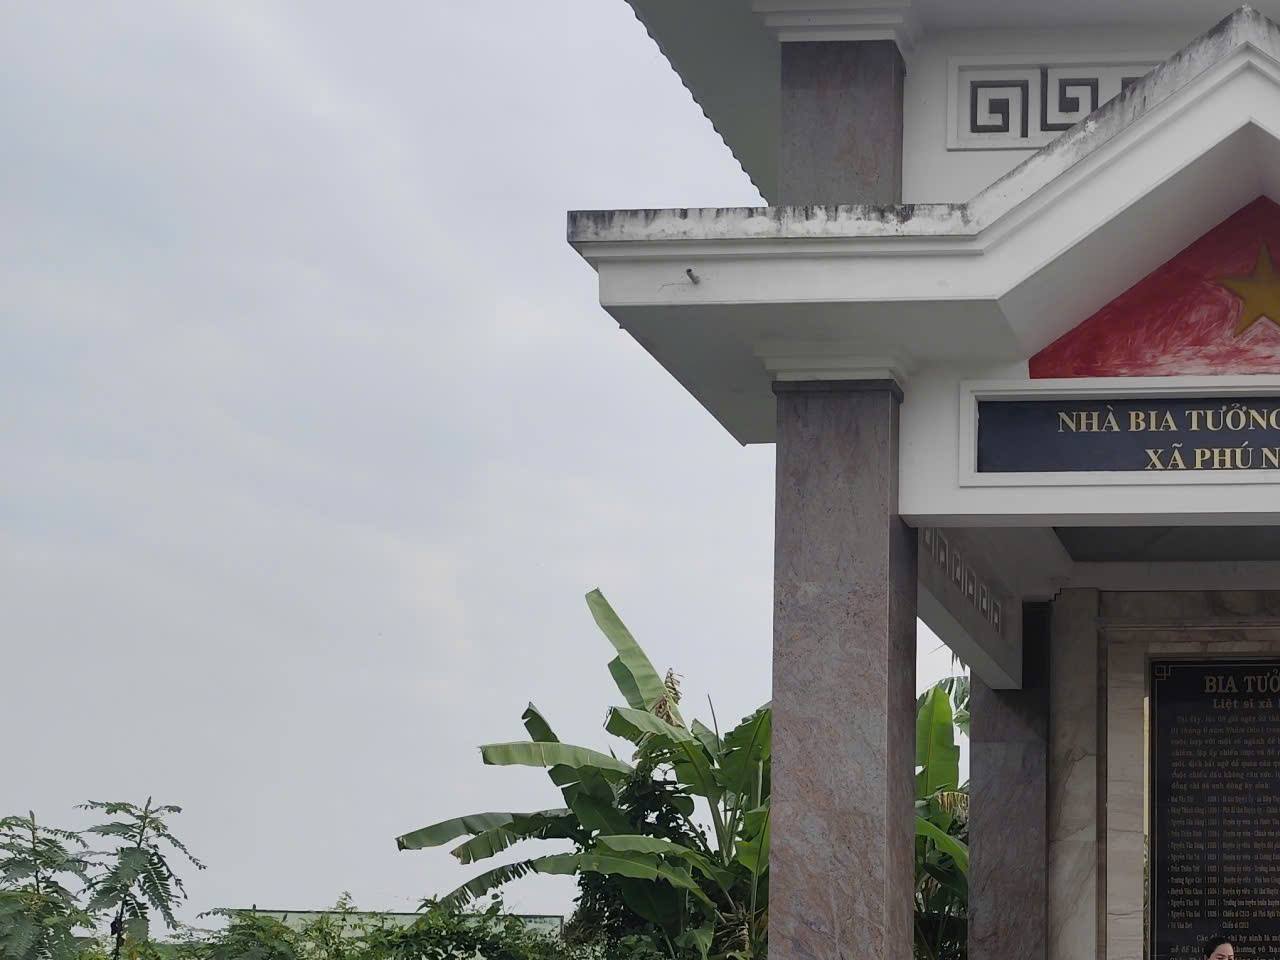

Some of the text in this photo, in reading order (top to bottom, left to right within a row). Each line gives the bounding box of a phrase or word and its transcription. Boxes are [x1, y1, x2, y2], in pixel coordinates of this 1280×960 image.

[1057, 405, 1121, 433] NHÀ
[1128, 411, 1178, 432] BIA
[1145, 442, 1184, 470] XÃ
[1194, 440, 1251, 469] PHÚ
[1204, 675, 1239, 693] BIA
[1213, 698, 1239, 711] Liệt
